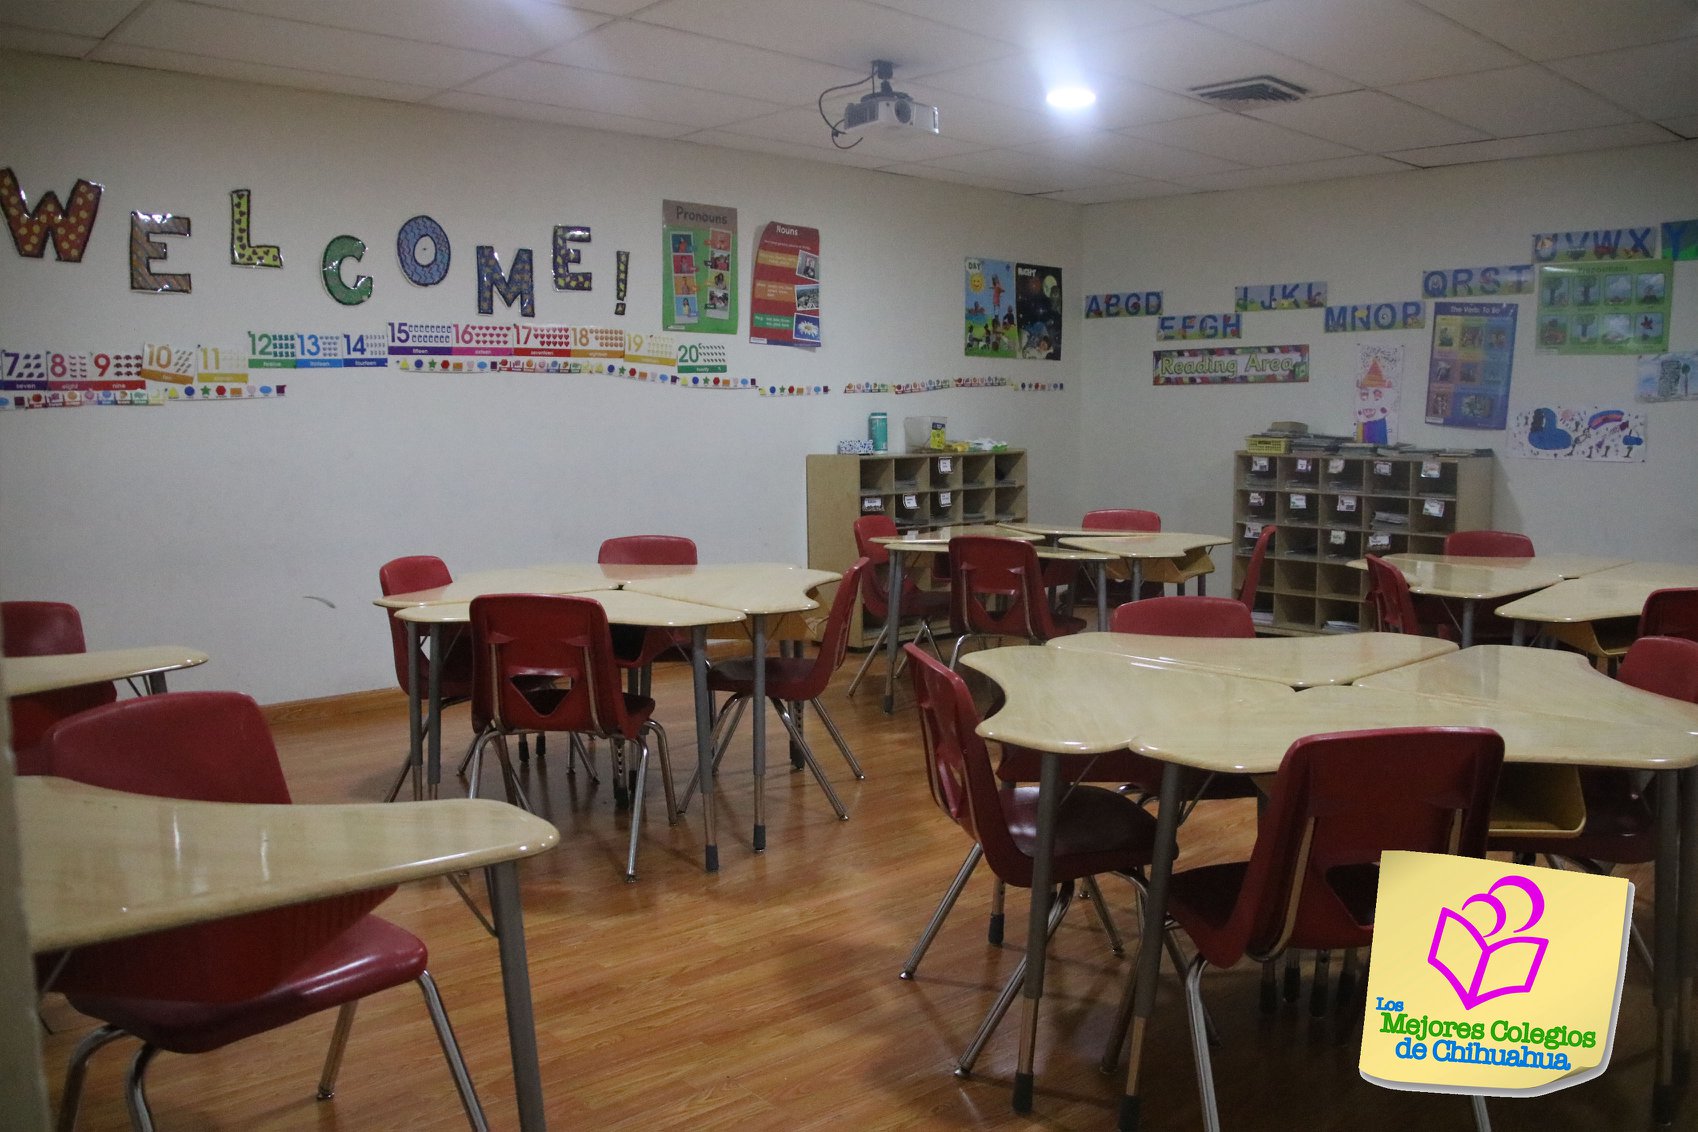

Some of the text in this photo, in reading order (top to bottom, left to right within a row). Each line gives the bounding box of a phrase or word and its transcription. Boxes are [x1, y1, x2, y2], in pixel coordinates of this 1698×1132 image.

[676, 206, 728, 225] Pronouns
[776, 225, 799, 236] Nouns
[968, 262, 982, 270] DAY
[1018, 267, 1037, 277] NIGHT
[1424, 264, 1535, 298] QRST
[1325, 302, 1422, 333] MNOP
[388, 322, 410, 344] 15
[453, 324, 474, 345] 16
[514, 325, 532, 345] 17
[571, 328, 590, 347] 18
[627, 334, 644, 352] 19
[249, 333, 272, 356] 12
[297, 334, 321, 356] 13
[343, 334, 366, 356] 14
[678, 345, 699, 363] 20
[4, 352, 20, 377] 7
[51, 353, 67, 378] 8
[94, 353, 111, 377] 9
[147, 344, 172, 369] 10
[201, 347, 220, 370] 11
[1161, 353, 1294, 377] Reading Area
